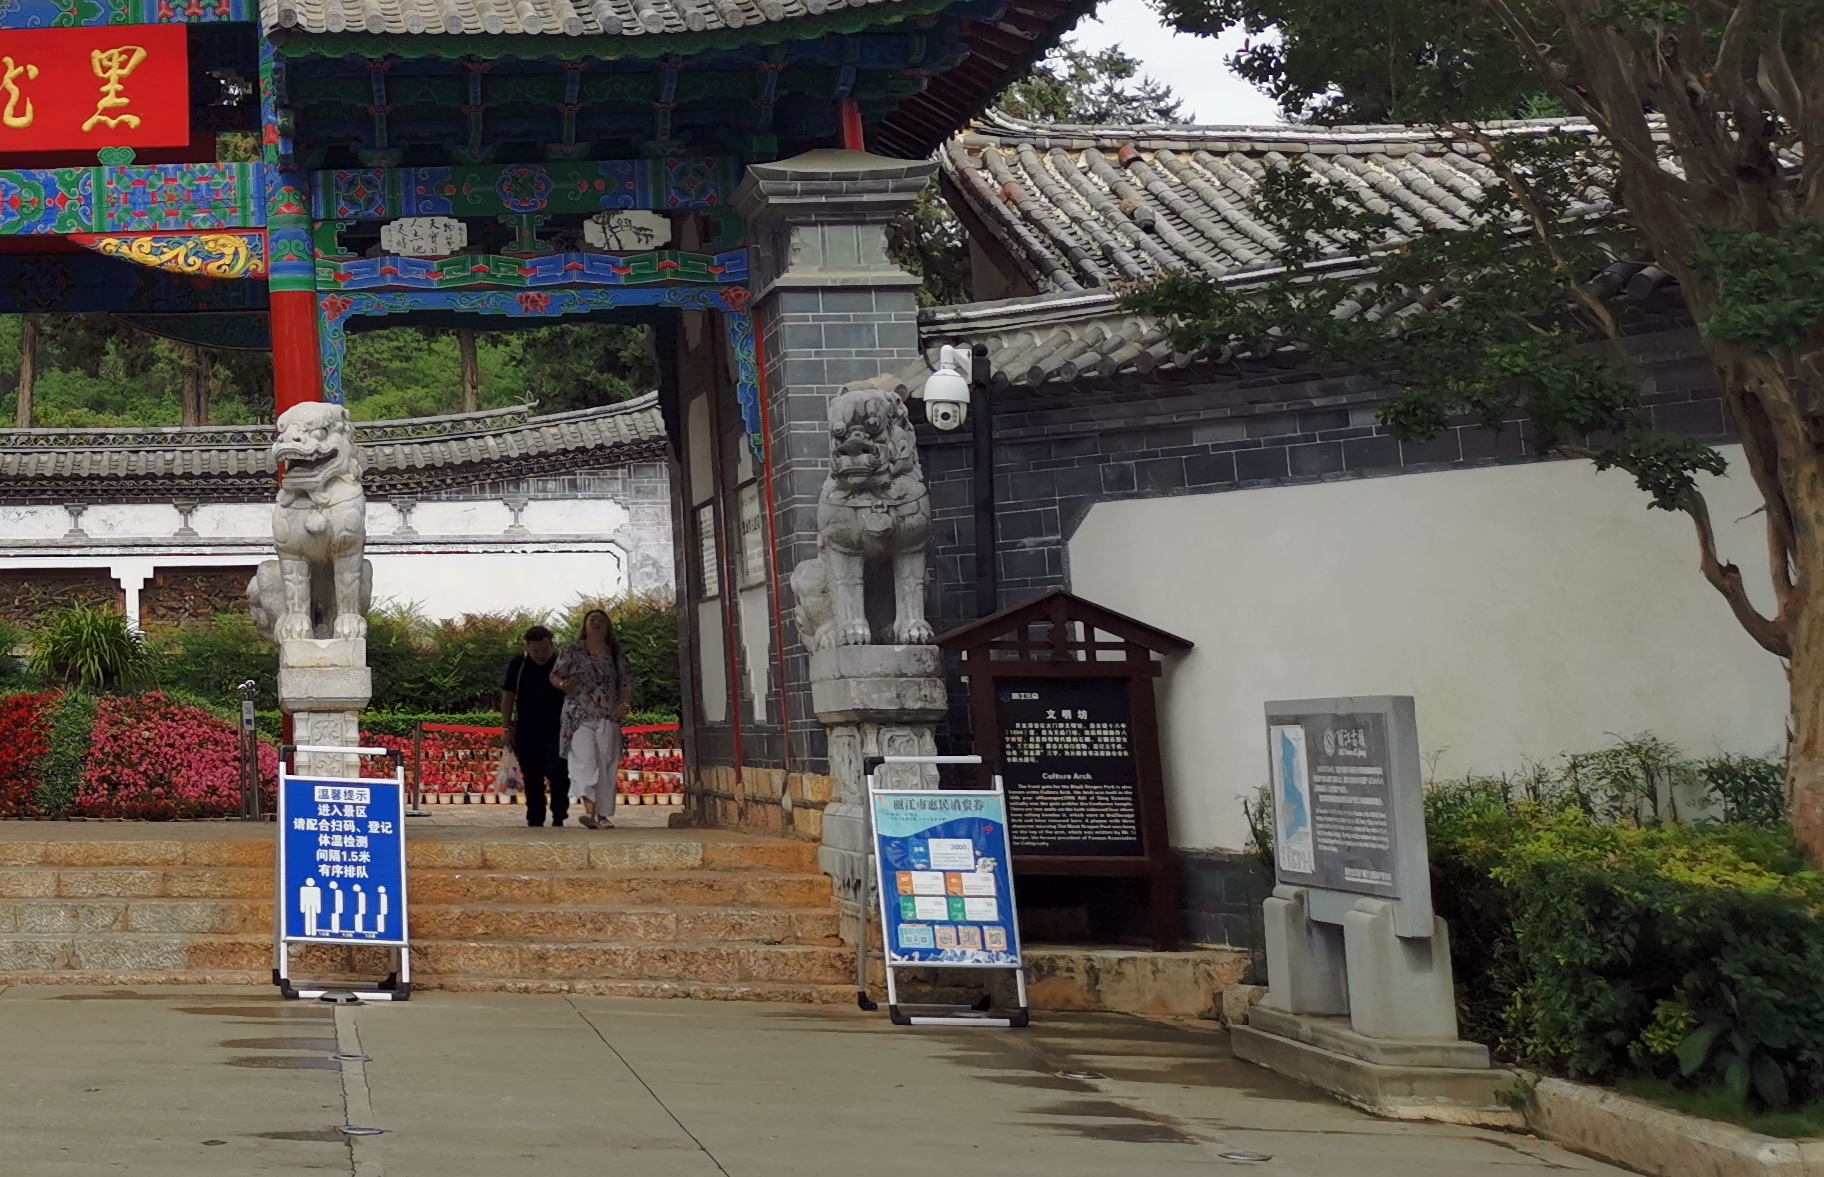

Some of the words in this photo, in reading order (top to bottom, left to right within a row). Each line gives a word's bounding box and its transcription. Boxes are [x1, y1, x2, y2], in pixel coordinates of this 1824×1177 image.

[1045, 708, 1088, 720] 文明坊
[318, 788, 367, 801] 温馨提示
[318, 804, 367, 817] 进入景区
[293, 818, 393, 833] 请配合扫码、登记
[318, 834, 368, 848] 体温检测
[316, 849, 371, 863] 间隔1.5米
[318, 864, 369, 878] 有序排队
